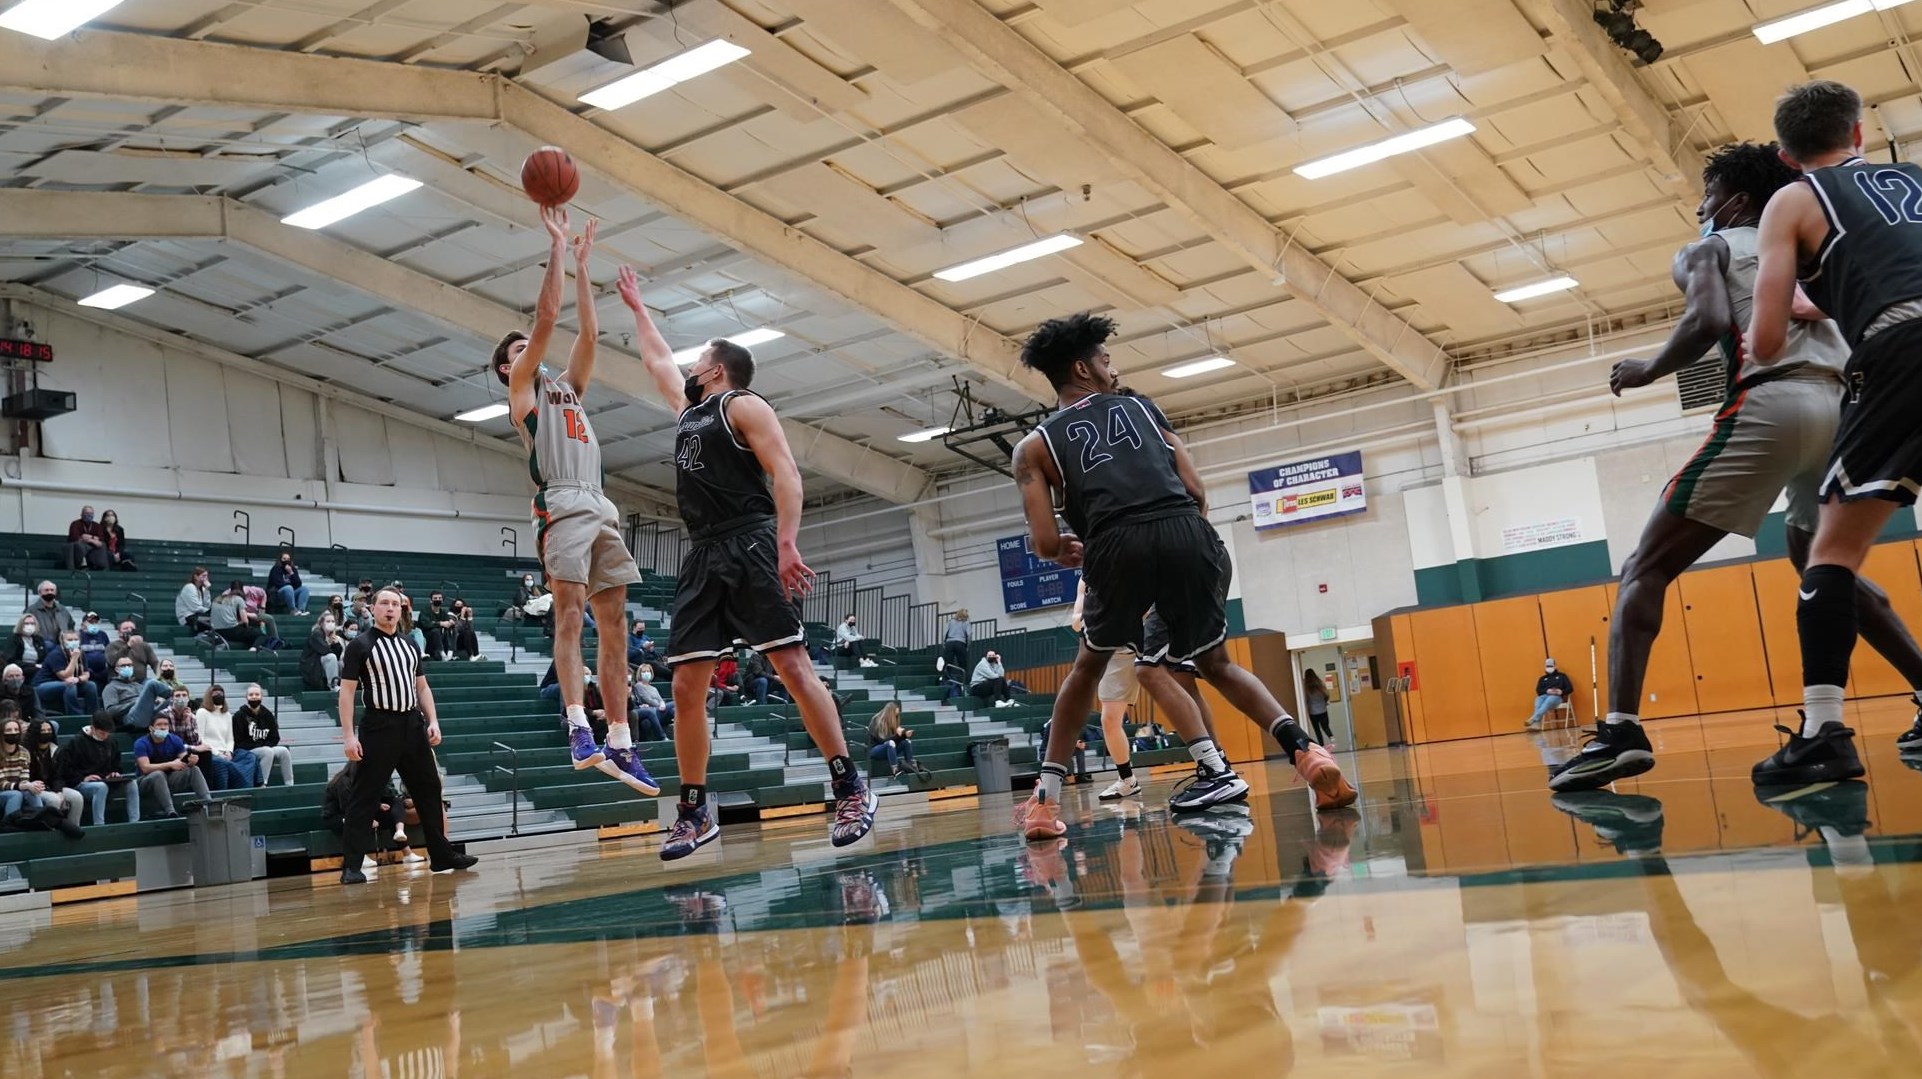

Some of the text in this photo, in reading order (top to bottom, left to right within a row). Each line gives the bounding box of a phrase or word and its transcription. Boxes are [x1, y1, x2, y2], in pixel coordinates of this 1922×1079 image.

[1853, 168, 1922, 226] 12
[563, 408, 589, 444] 12
[1066, 404, 1142, 474] 24
[677, 434, 704, 471] 42
[1273, 467, 1339, 488] OF CHARACTER
[1279, 459, 1330, 477] CHAMPIONS
[1298, 497, 1309, 505] LES
[1309, 493, 1334, 503] SCHWAB
[1000, 540, 1021, 551] HOME
[1007, 573, 1059, 588] FOULS PLAYER
[1009, 596, 1062, 611] SCORE MATCH
